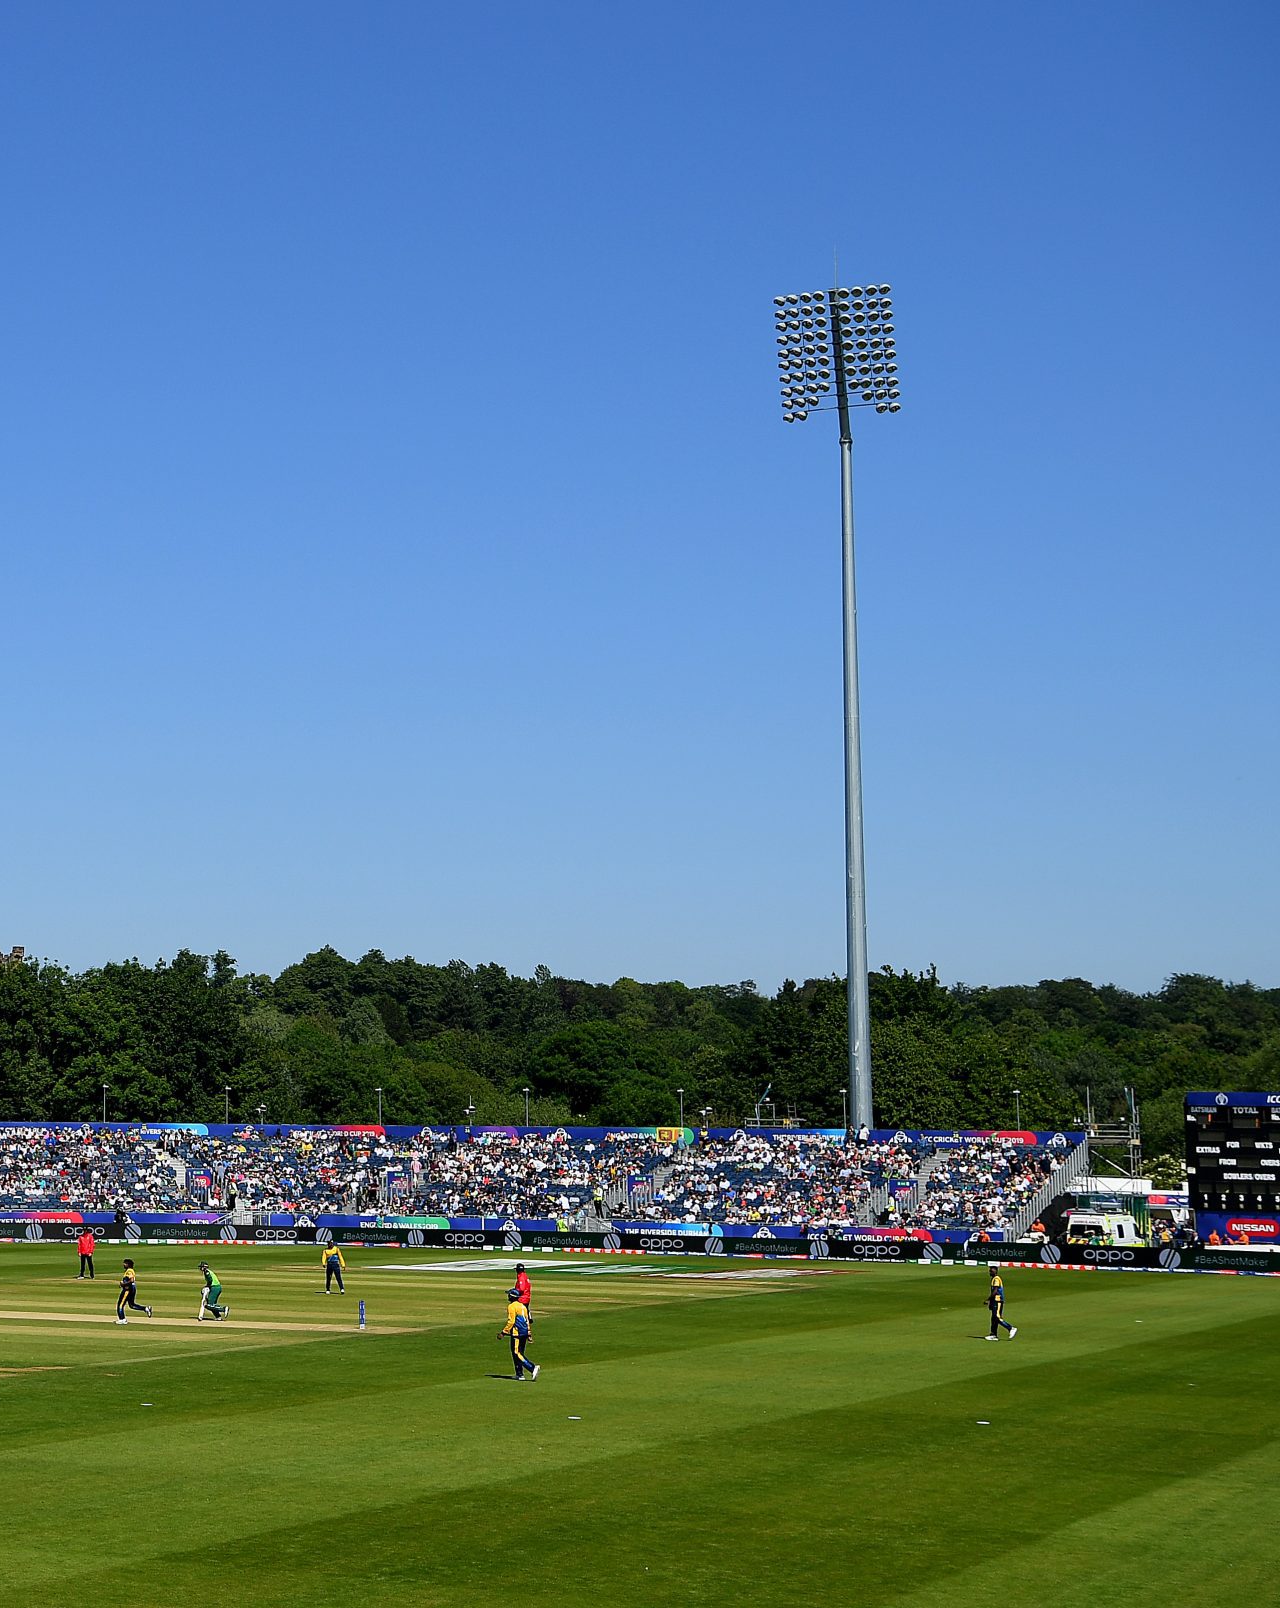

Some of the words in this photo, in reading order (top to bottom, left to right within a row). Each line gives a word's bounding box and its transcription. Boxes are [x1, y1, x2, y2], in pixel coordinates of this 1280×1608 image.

[1232, 1224, 1274, 1232] NISSAN
[255, 1229, 297, 1240] oppo
[445, 1233, 485, 1244] oppo
[533, 1237, 591, 1246] #BeAShotMaker
[640, 1238, 684, 1249] oppo
[735, 1243, 797, 1253] #BeAShotMaker
[853, 1244, 900, 1256] oppo
[1084, 1249, 1134, 1262] oppo
[1194, 1256, 1269, 1266] #BeAShotMaker
